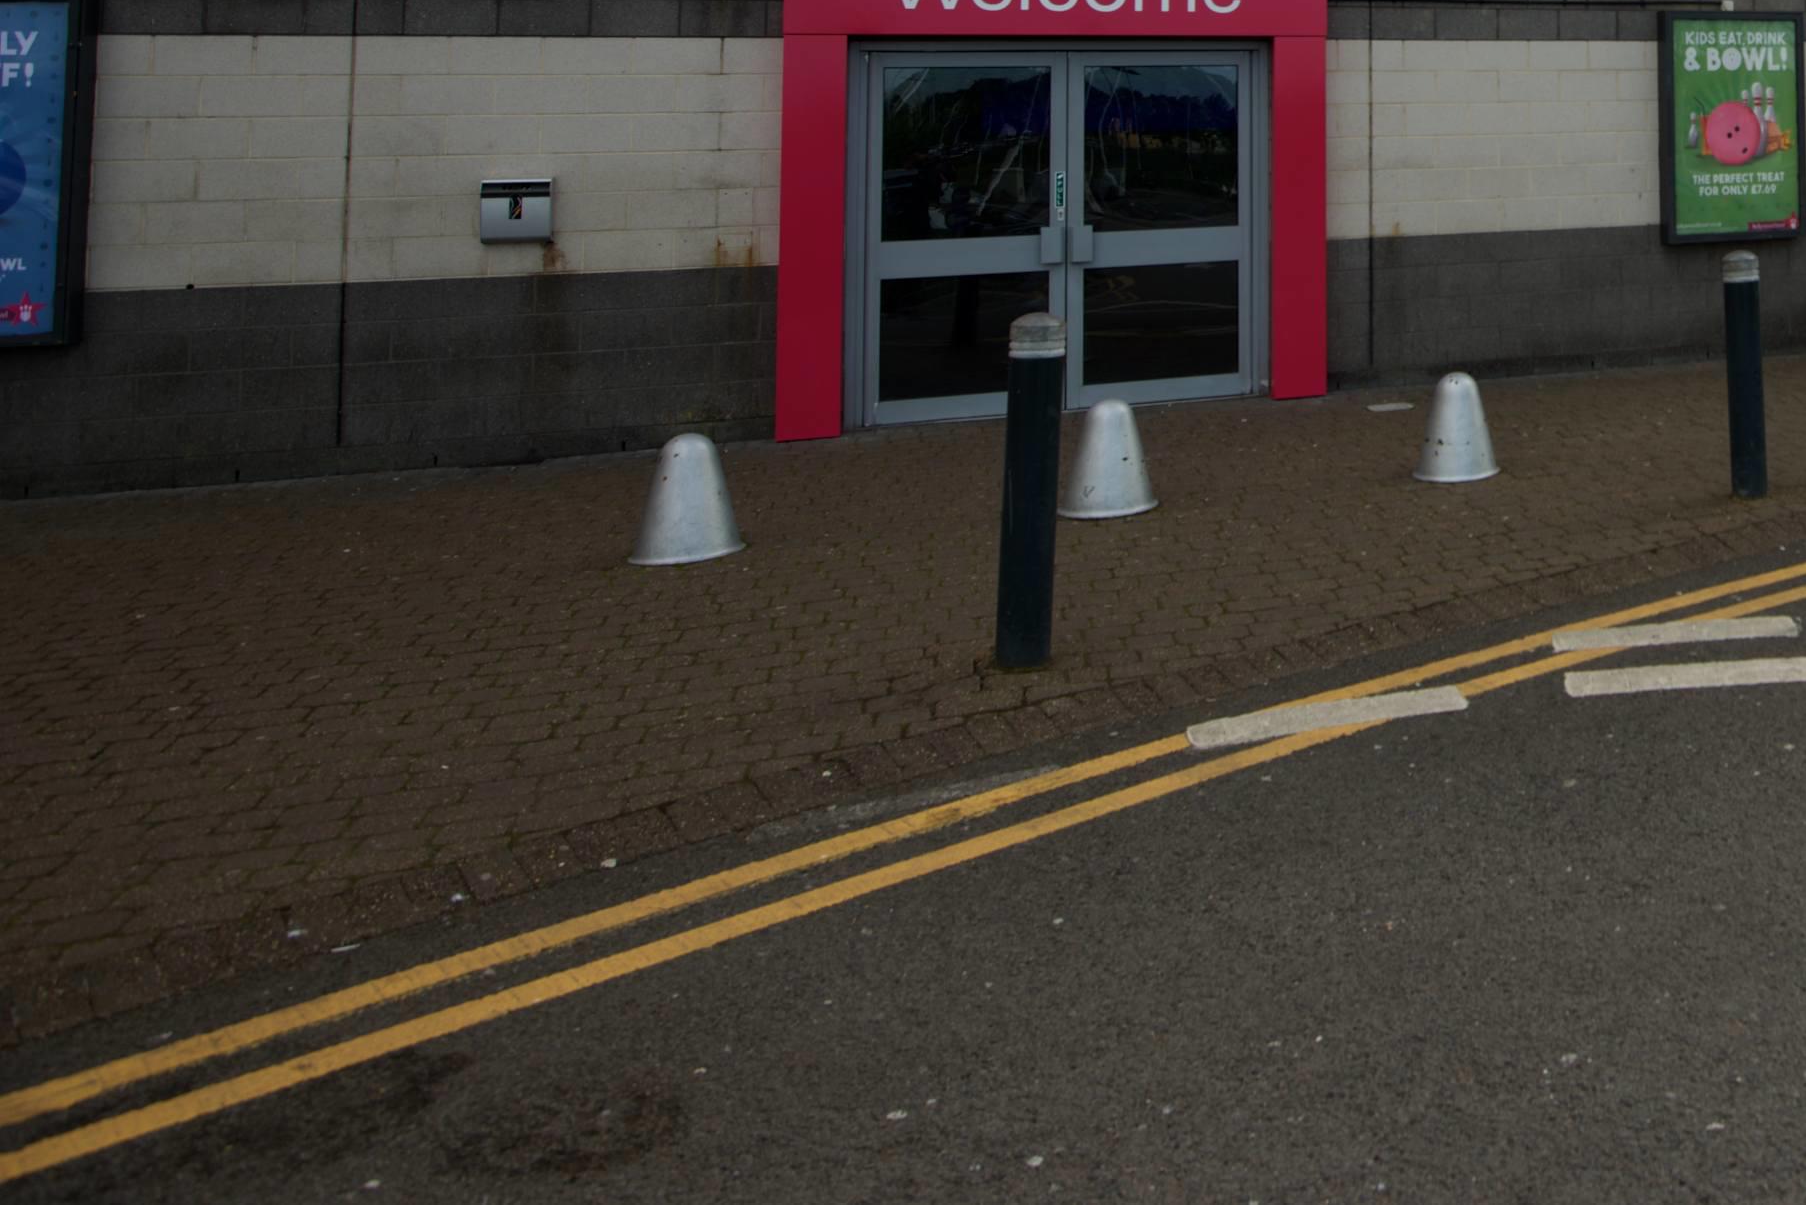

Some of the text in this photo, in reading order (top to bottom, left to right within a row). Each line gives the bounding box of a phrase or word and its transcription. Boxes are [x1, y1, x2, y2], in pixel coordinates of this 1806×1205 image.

[1684, 31, 1716, 45] KIDS
[1747, 31, 1787, 45] DRINK
[1684, 47, 1788, 71] & BOWL!
[0, 62, 34, 88] F!
[1692, 171, 1785, 185] THE PERFECT TREAT
[1699, 186, 1719, 197] FOR
[1722, 185, 1749, 196] ONLY
